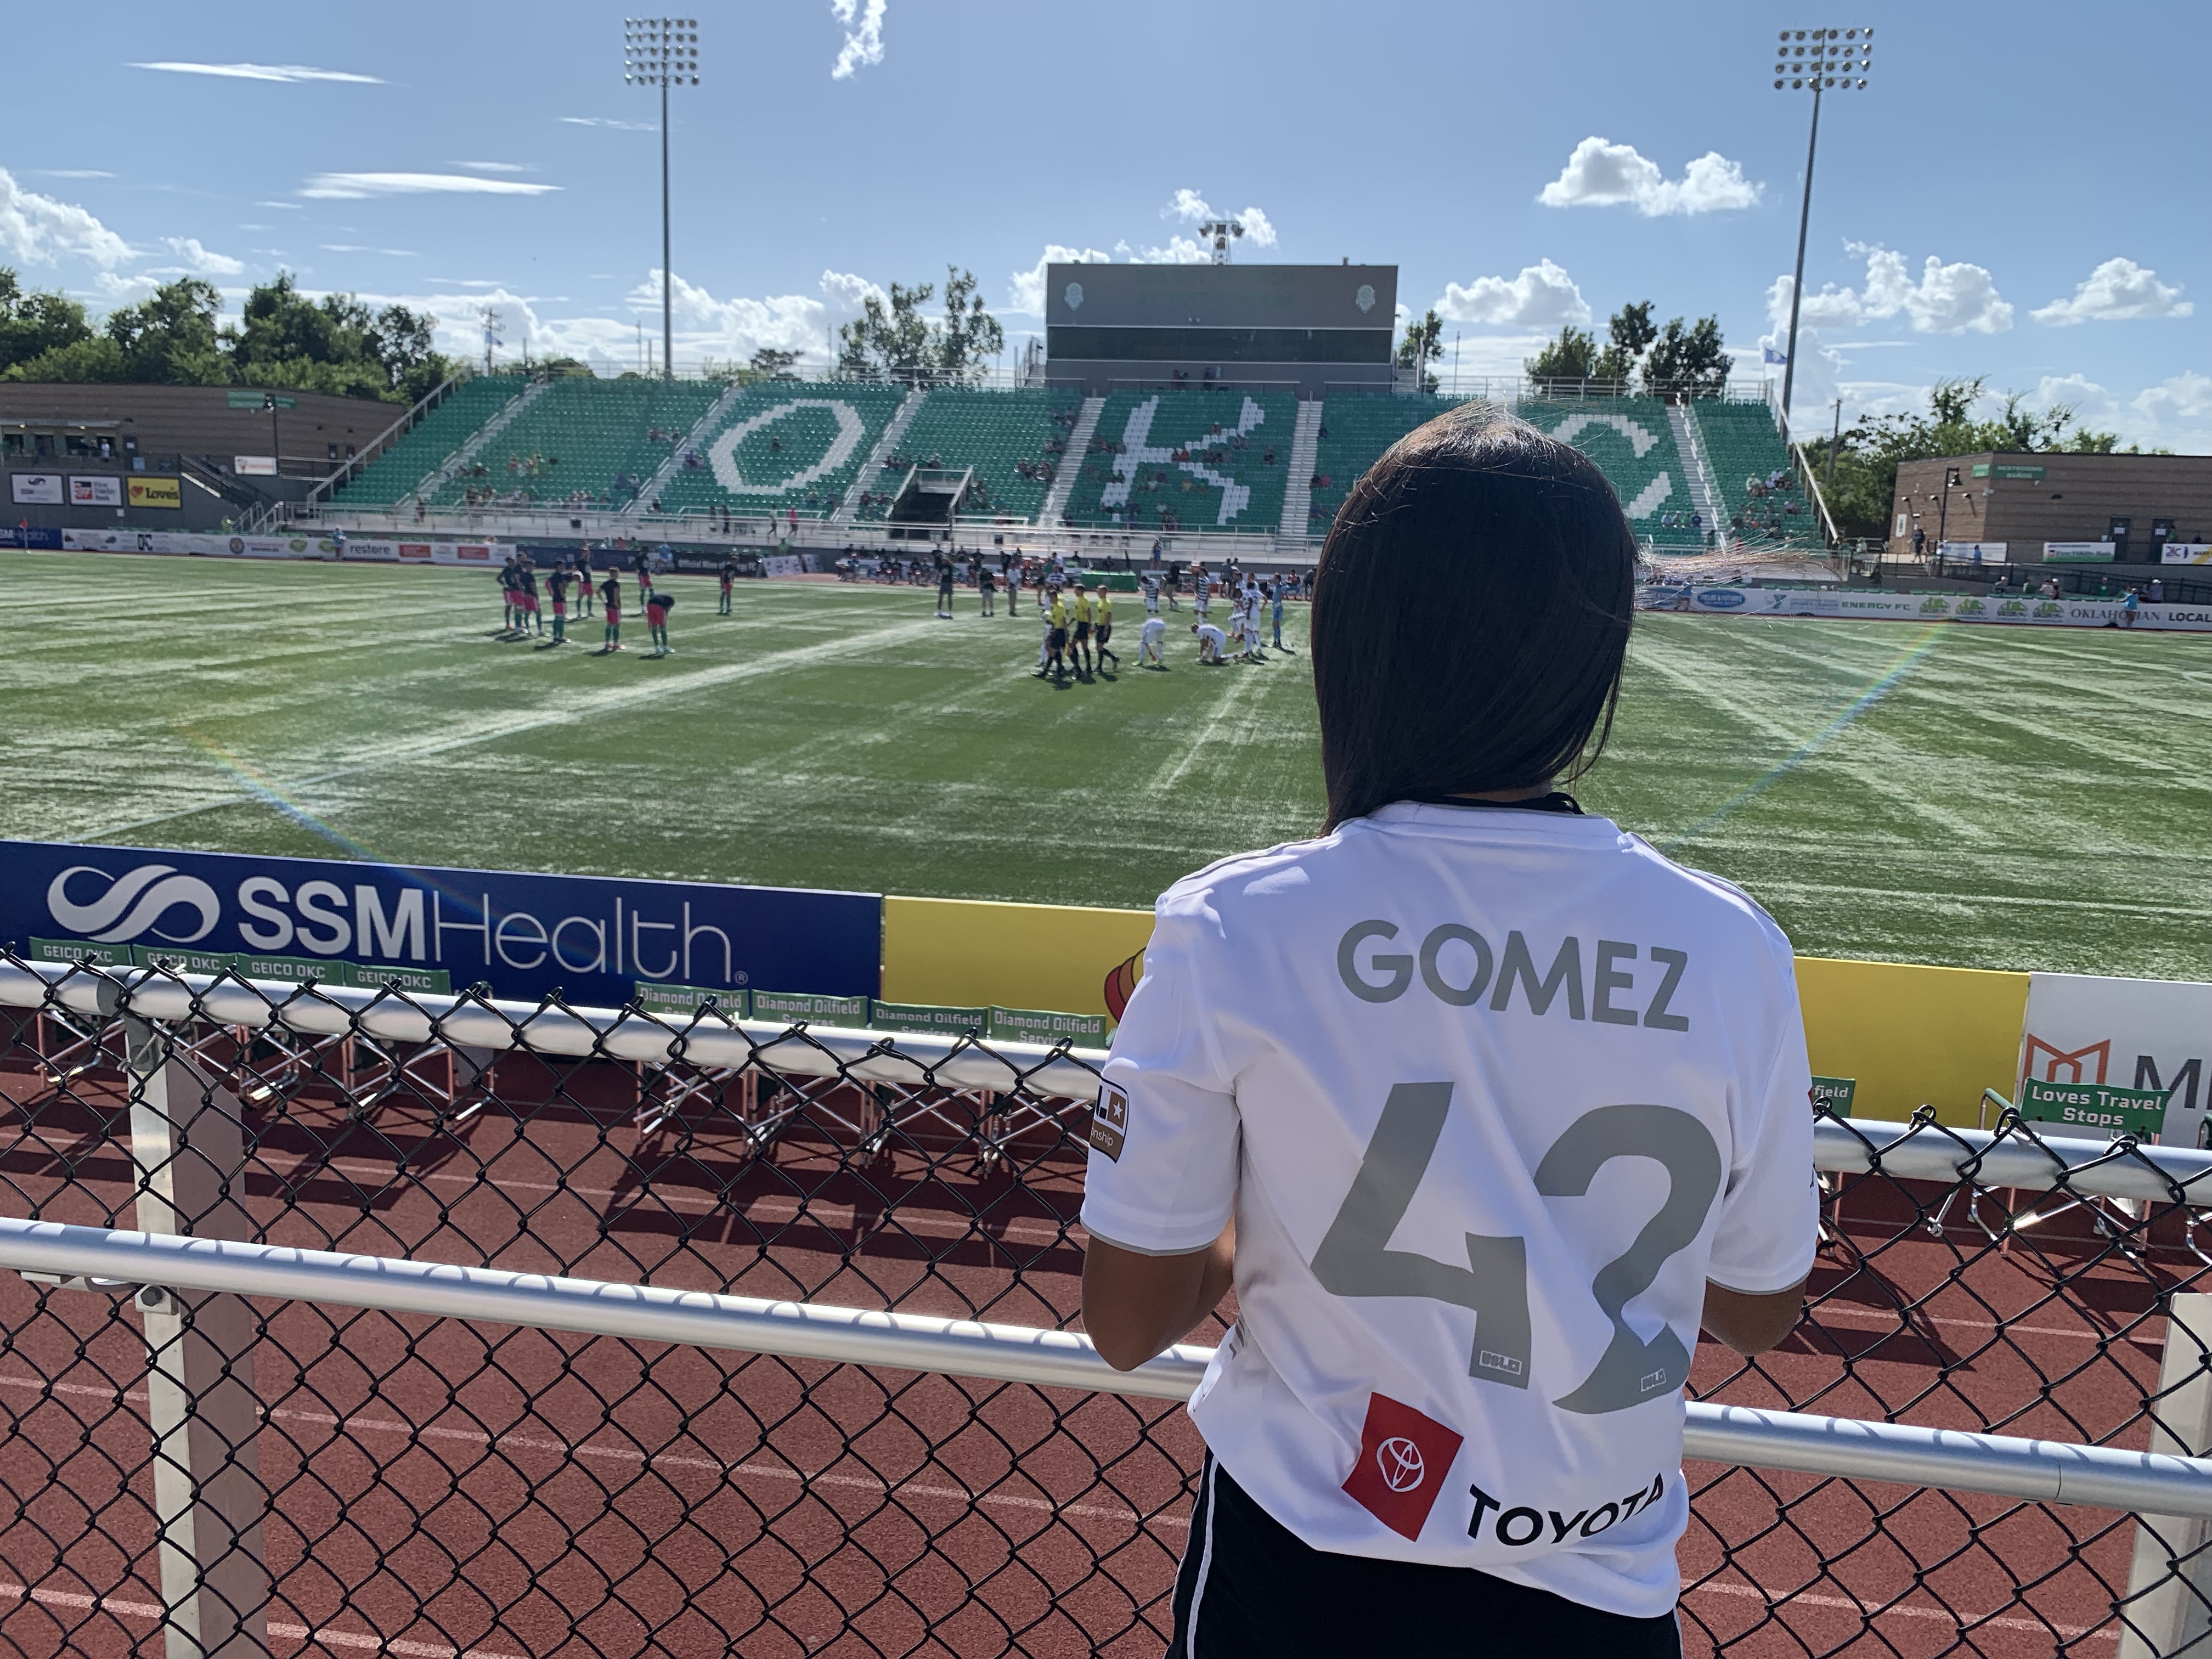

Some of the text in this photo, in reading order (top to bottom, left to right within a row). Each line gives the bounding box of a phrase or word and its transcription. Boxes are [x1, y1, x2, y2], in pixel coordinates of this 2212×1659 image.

[43, 945, 82, 959] GEICO
[191, 956, 221, 970] OKC
[251, 961, 325, 979] GEICO OKC
[402, 974, 431, 989] OKC
[1337, 919, 1689, 1032] GOMEZ
[640, 987, 693, 1006] Diamond
[757, 995, 860, 1014] Diamond Oilfield
[876, 1008, 983, 1026] Diamond Oilfield
[994, 1011, 1101, 1033] Diamond Oilfield
[2032, 1086, 2162, 1111] Loves Travel
[2062, 1107, 2124, 1127] Stops
[1309, 1081, 1723, 1415] 42
[1467, 1472, 1664, 1547] TOYOTA
